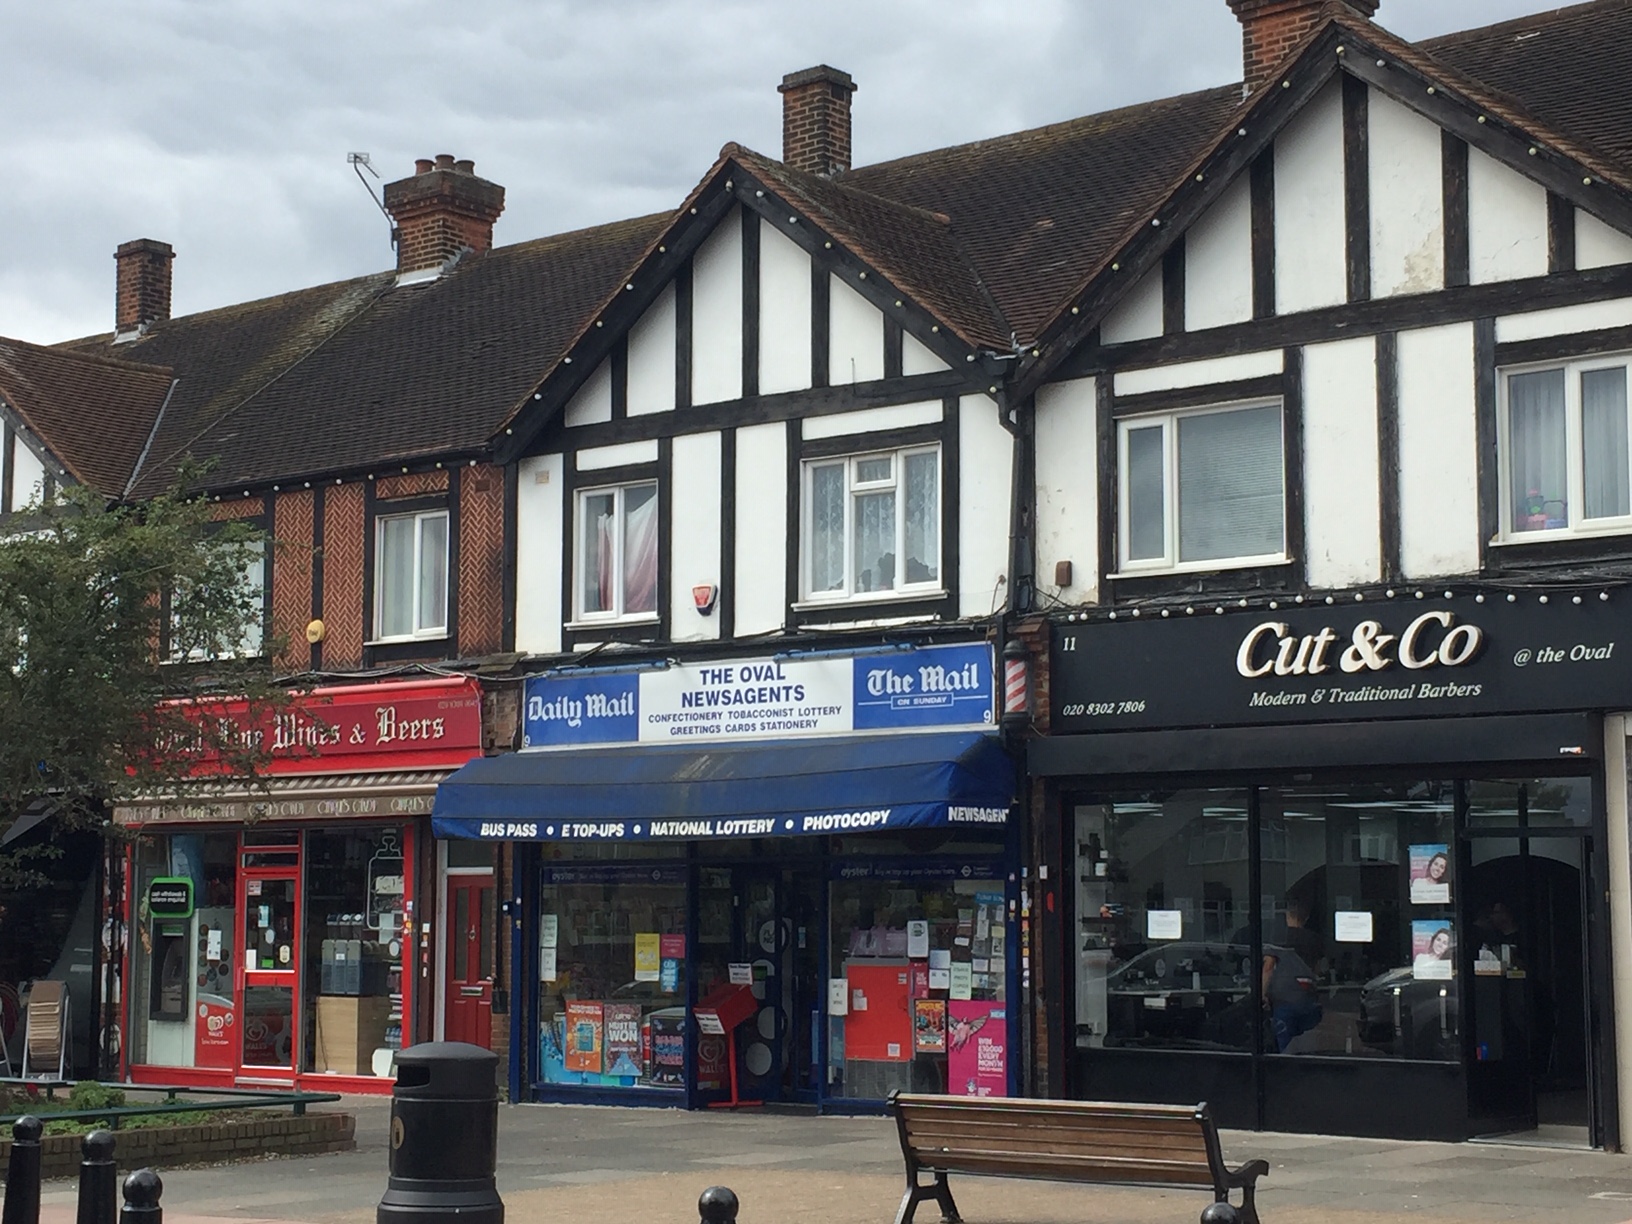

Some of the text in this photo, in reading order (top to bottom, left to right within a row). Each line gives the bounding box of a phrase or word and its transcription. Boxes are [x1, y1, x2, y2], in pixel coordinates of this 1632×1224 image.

[1063, 637, 1076, 651] 11
[1236, 621, 1340, 678] Cut
[1513, 642, 1615, 667] @ the Oval
[700, 663, 786, 686] THE OVAL
[867, 663, 979, 696] The Mail
[681, 684, 805, 709] NEWSAGENTS
[897, 696, 947, 706] ON SUNDAY
[1249, 682, 1482, 707] Modern & Traditional Barbers
[528, 691, 635, 728] Daily Mail
[648, 705, 842, 723] CONFECTIONERY TOBACCONIST LOTTERY
[983, 709, 992, 723] 9
[1062, 700, 1146, 716] 020 8302 7806
[349, 722, 366, 744] &
[375, 705, 445, 746] Beers
[670, 719, 819, 736] GREETINGS CARDS STATIONERY
[524, 735, 531, 747] 9
[650, 819, 775, 836] NATIONAL LOTTERY
[802, 809, 892, 831] PHOTOCOPY
[480, 822, 537, 837] BUS PASS
[561, 823, 625, 837] E TOP-UPS
[609, 1030, 637, 1042] WON
